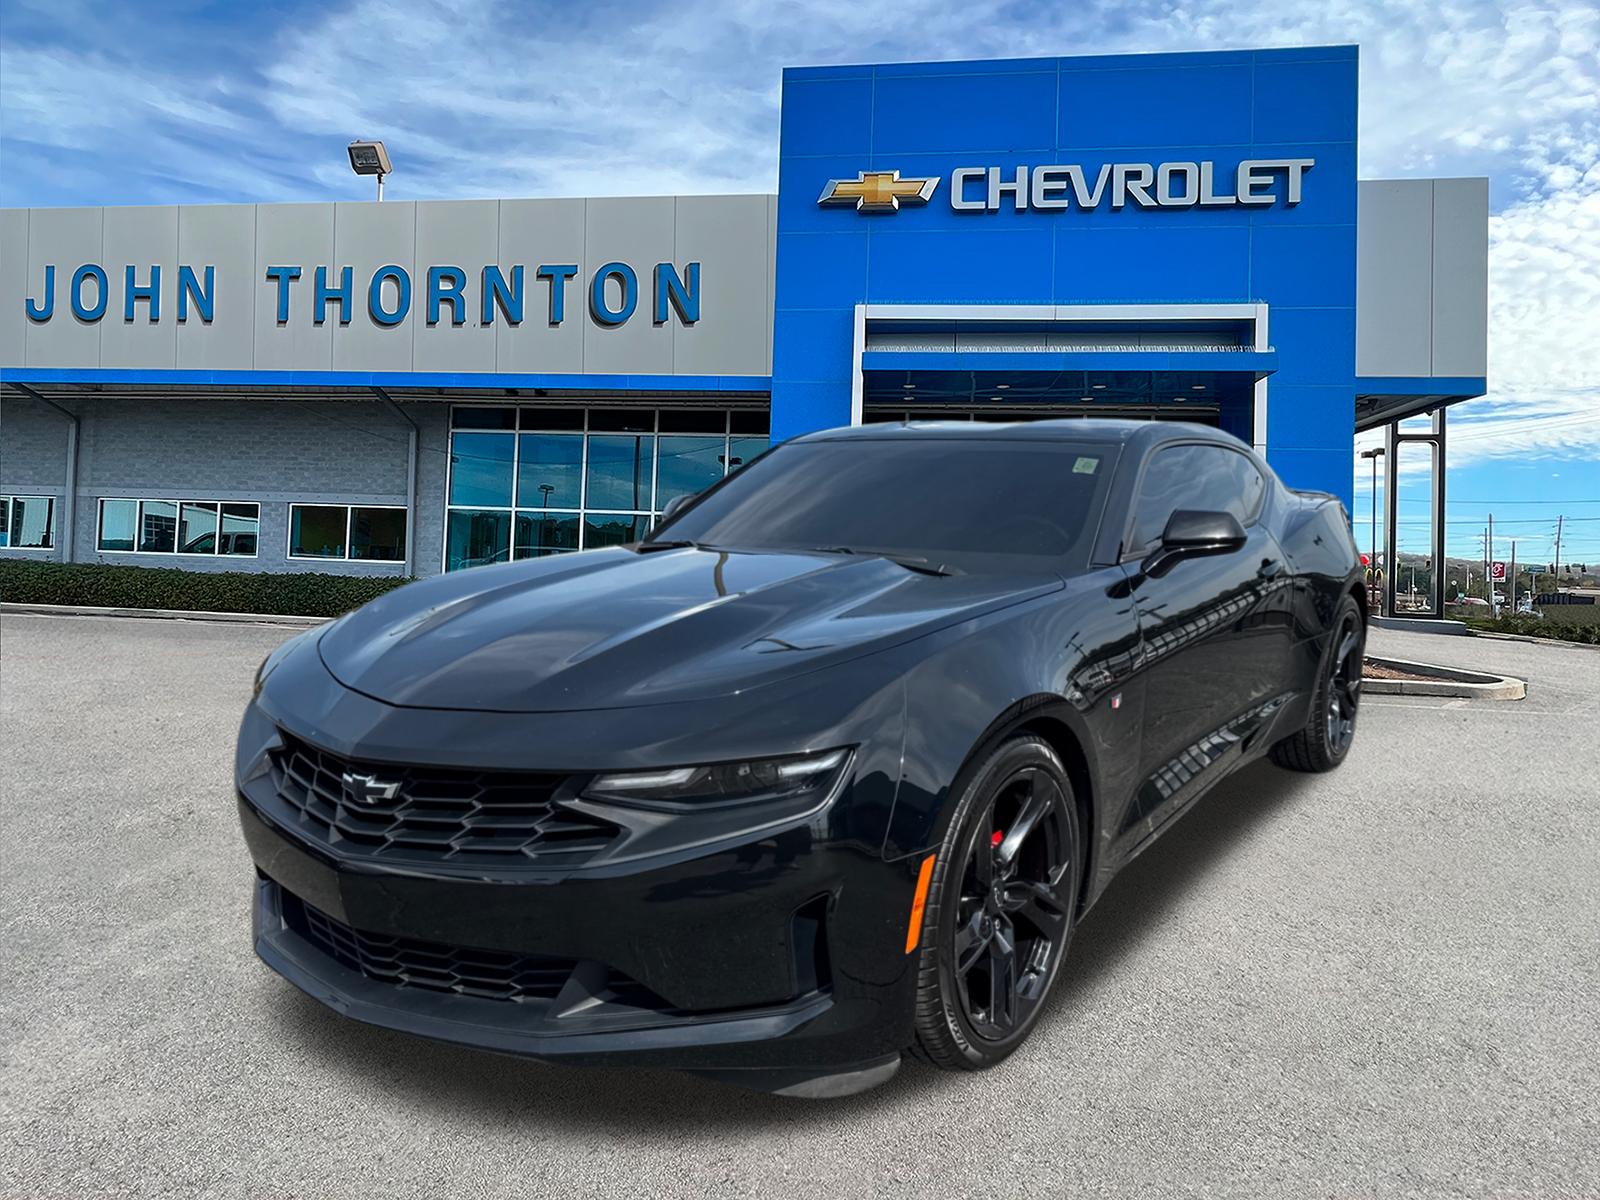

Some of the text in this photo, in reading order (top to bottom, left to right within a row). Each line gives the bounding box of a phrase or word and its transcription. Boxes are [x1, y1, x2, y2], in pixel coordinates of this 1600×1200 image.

[951, 158, 1315, 211] CHEVROLET
[25, 262, 701, 327] JOHN THORNTON
